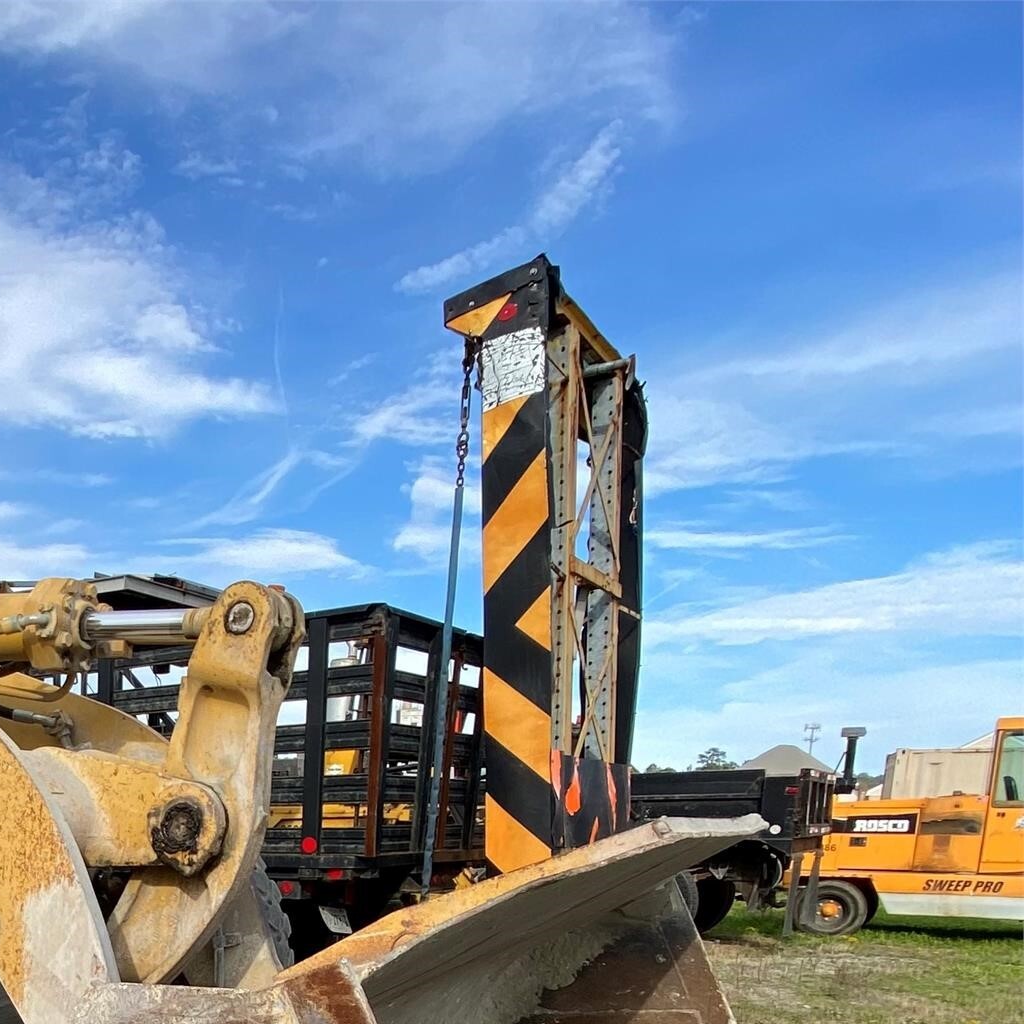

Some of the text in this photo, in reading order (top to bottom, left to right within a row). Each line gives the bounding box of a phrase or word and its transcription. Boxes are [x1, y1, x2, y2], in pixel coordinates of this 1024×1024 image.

[853, 819, 910, 833] ROSCO
[922, 879, 1004, 894] SWEEP PRO
